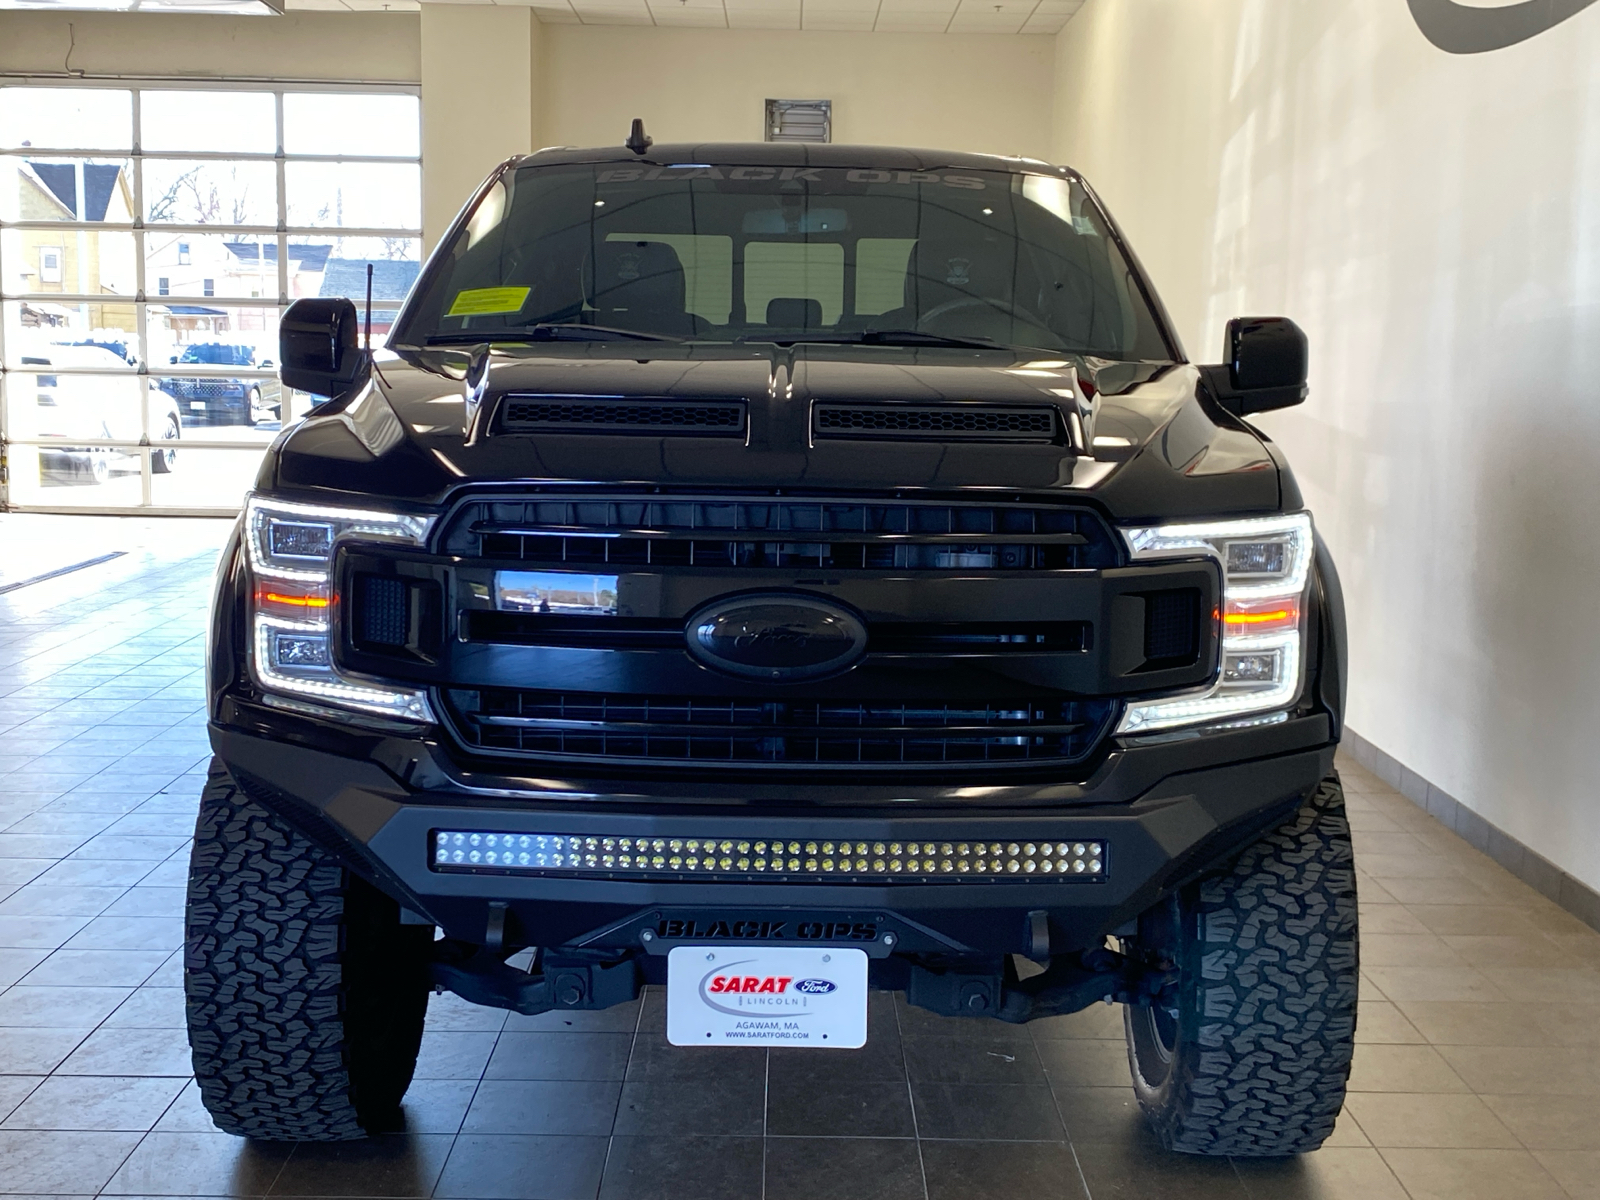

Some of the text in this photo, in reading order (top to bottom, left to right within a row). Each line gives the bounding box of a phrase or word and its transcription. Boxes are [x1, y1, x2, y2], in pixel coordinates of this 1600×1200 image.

[595, 167, 986, 190] BLACK OPS
[657, 919, 878, 940] BLACK OPS
[709, 975, 831, 994] SARAT Ford
[746, 997, 799, 1006] LINCOLN
[735, 1021, 799, 1031] AGAWAM, MA
[725, 1031, 810, 1039] WWW.SARATFORD.COM
